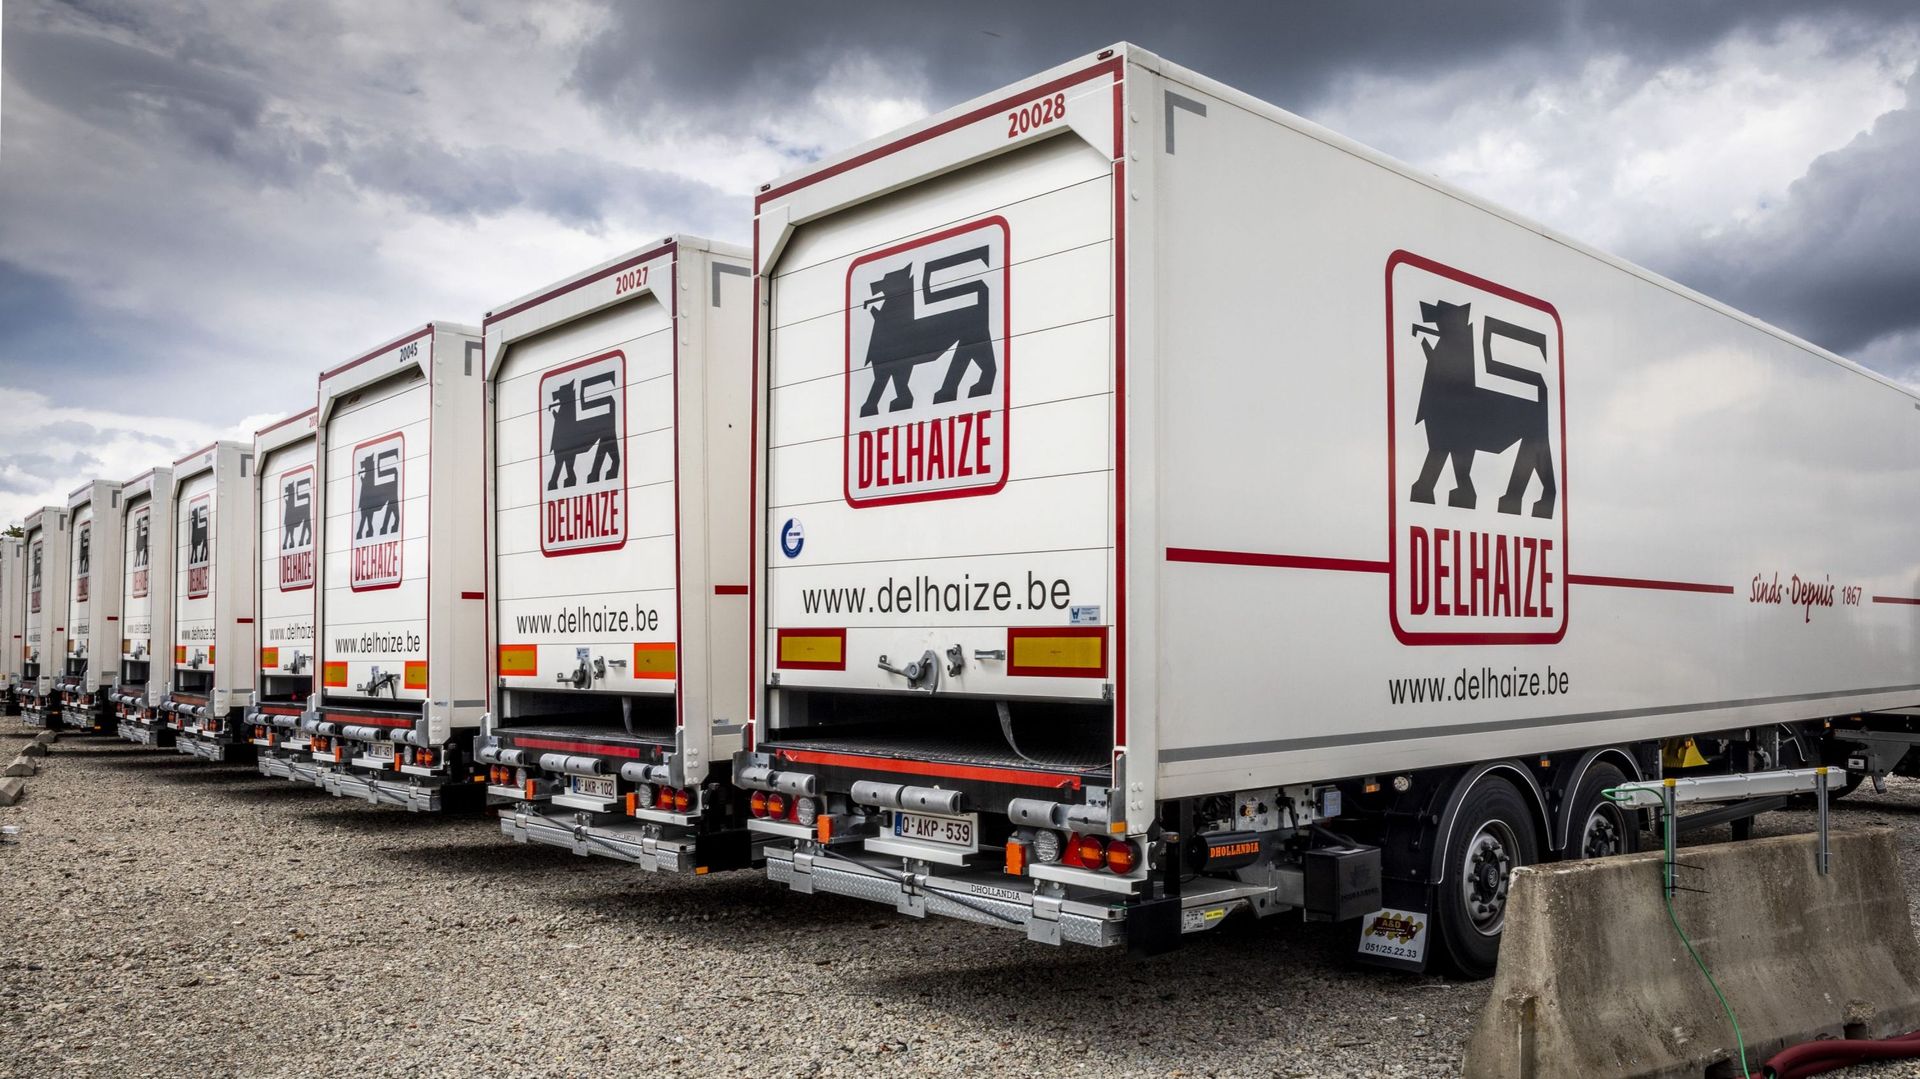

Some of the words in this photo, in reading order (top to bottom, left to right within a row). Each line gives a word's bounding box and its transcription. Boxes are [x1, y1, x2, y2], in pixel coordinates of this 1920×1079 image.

[1008, 93, 1065, 138] 20028
[616, 266, 648, 295] 20027
[400, 342, 418, 362] 20045
[858, 410, 992, 489] DELHAIZE
[548, 489, 619, 543] DELHAIZE
[282, 551, 311, 583] DELHAIZE
[355, 541, 398, 581] DELHAIZE
[1410, 525, 1554, 618] DELHAIZE
[803, 570, 1070, 613] www.delhaize.be
[1750, 571, 1782, 605] Sinds
[1791, 573, 1835, 623] Depuis
[1841, 586, 1862, 606] 1867
[516, 603, 658, 634] www.delhaize.be
[335, 630, 421, 653] www.delhaize.be
[1388, 665, 1569, 705] www.delhaize.be
[1209, 842, 1260, 858] DHOLLANDIA
[970, 884, 1021, 901] DHOLLANDIA
[1365, 942, 1417, 958] 051/25.22.33
